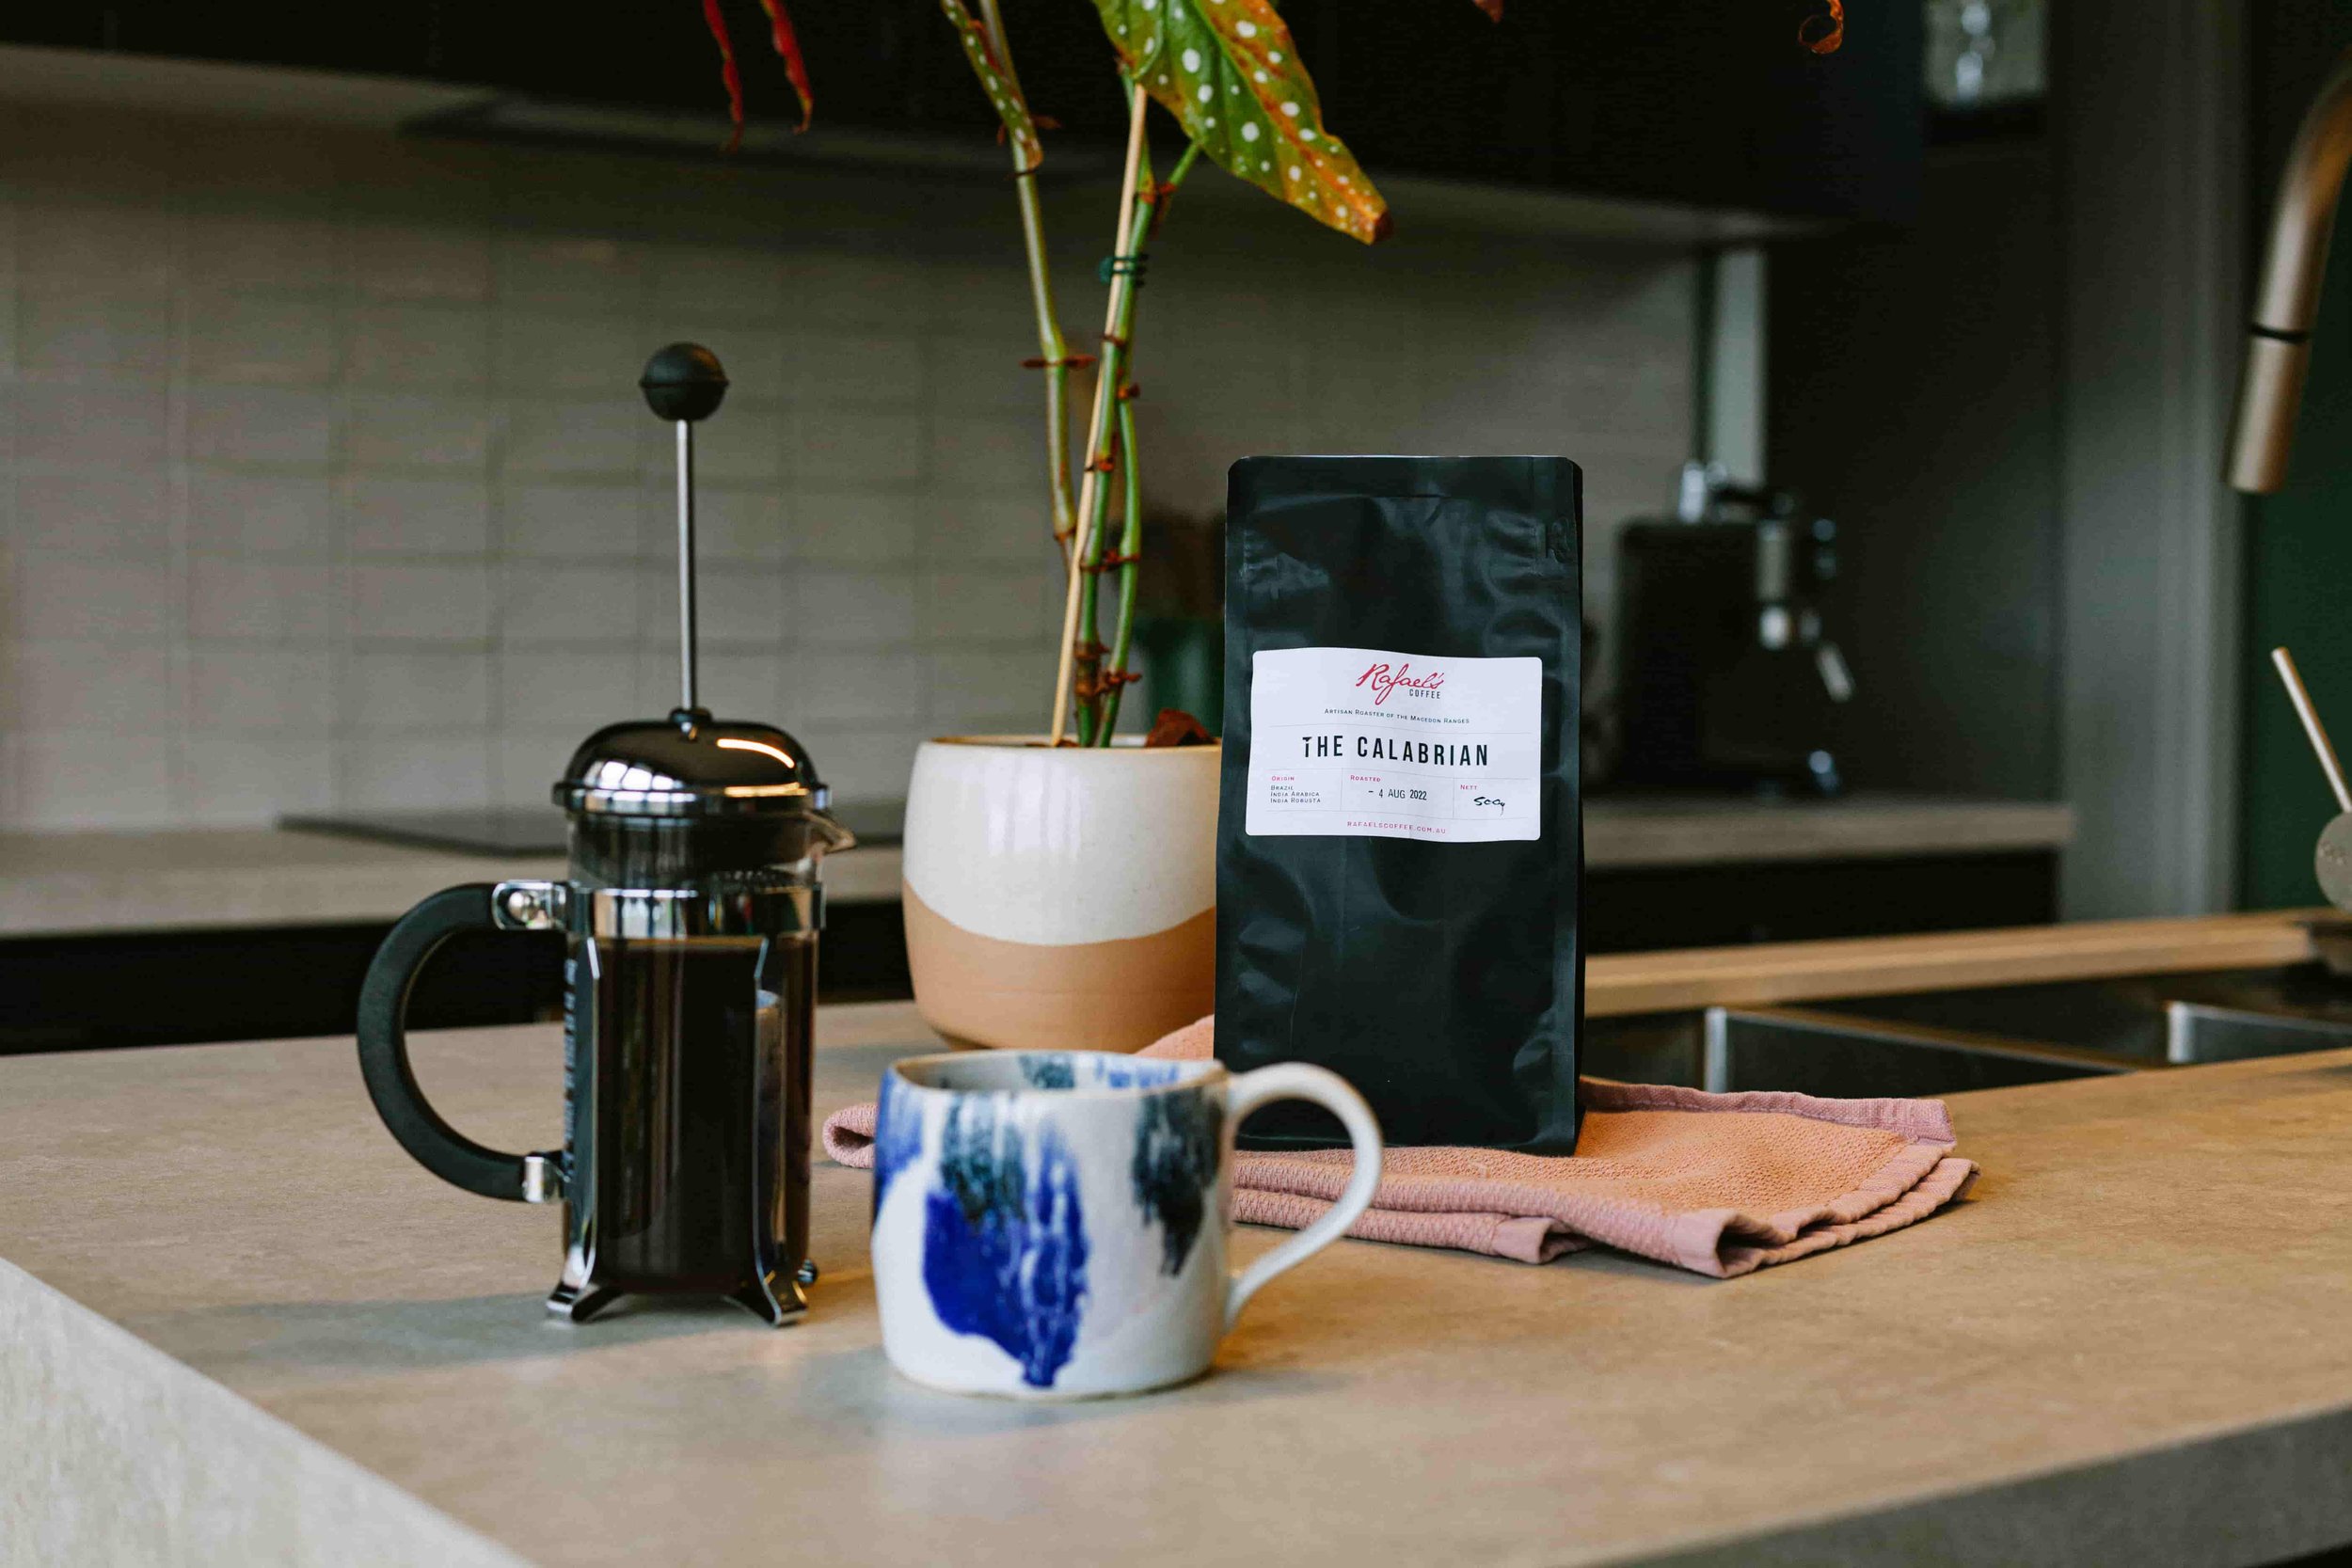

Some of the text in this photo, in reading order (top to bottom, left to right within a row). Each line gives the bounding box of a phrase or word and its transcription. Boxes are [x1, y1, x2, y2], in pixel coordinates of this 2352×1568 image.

[1355, 663, 1445, 705] Rafael's
[1408, 688, 1441, 700] COFFEE
[1302, 735, 1487, 767] THE CALABRIAN
[1378, 788, 1384, 799] 4
[1388, 788, 1406, 800] AUG
[1409, 789, 1427, 801] 2022
[1346, 820, 1446, 834] RAFAELSCOFFEE.COM.AU
